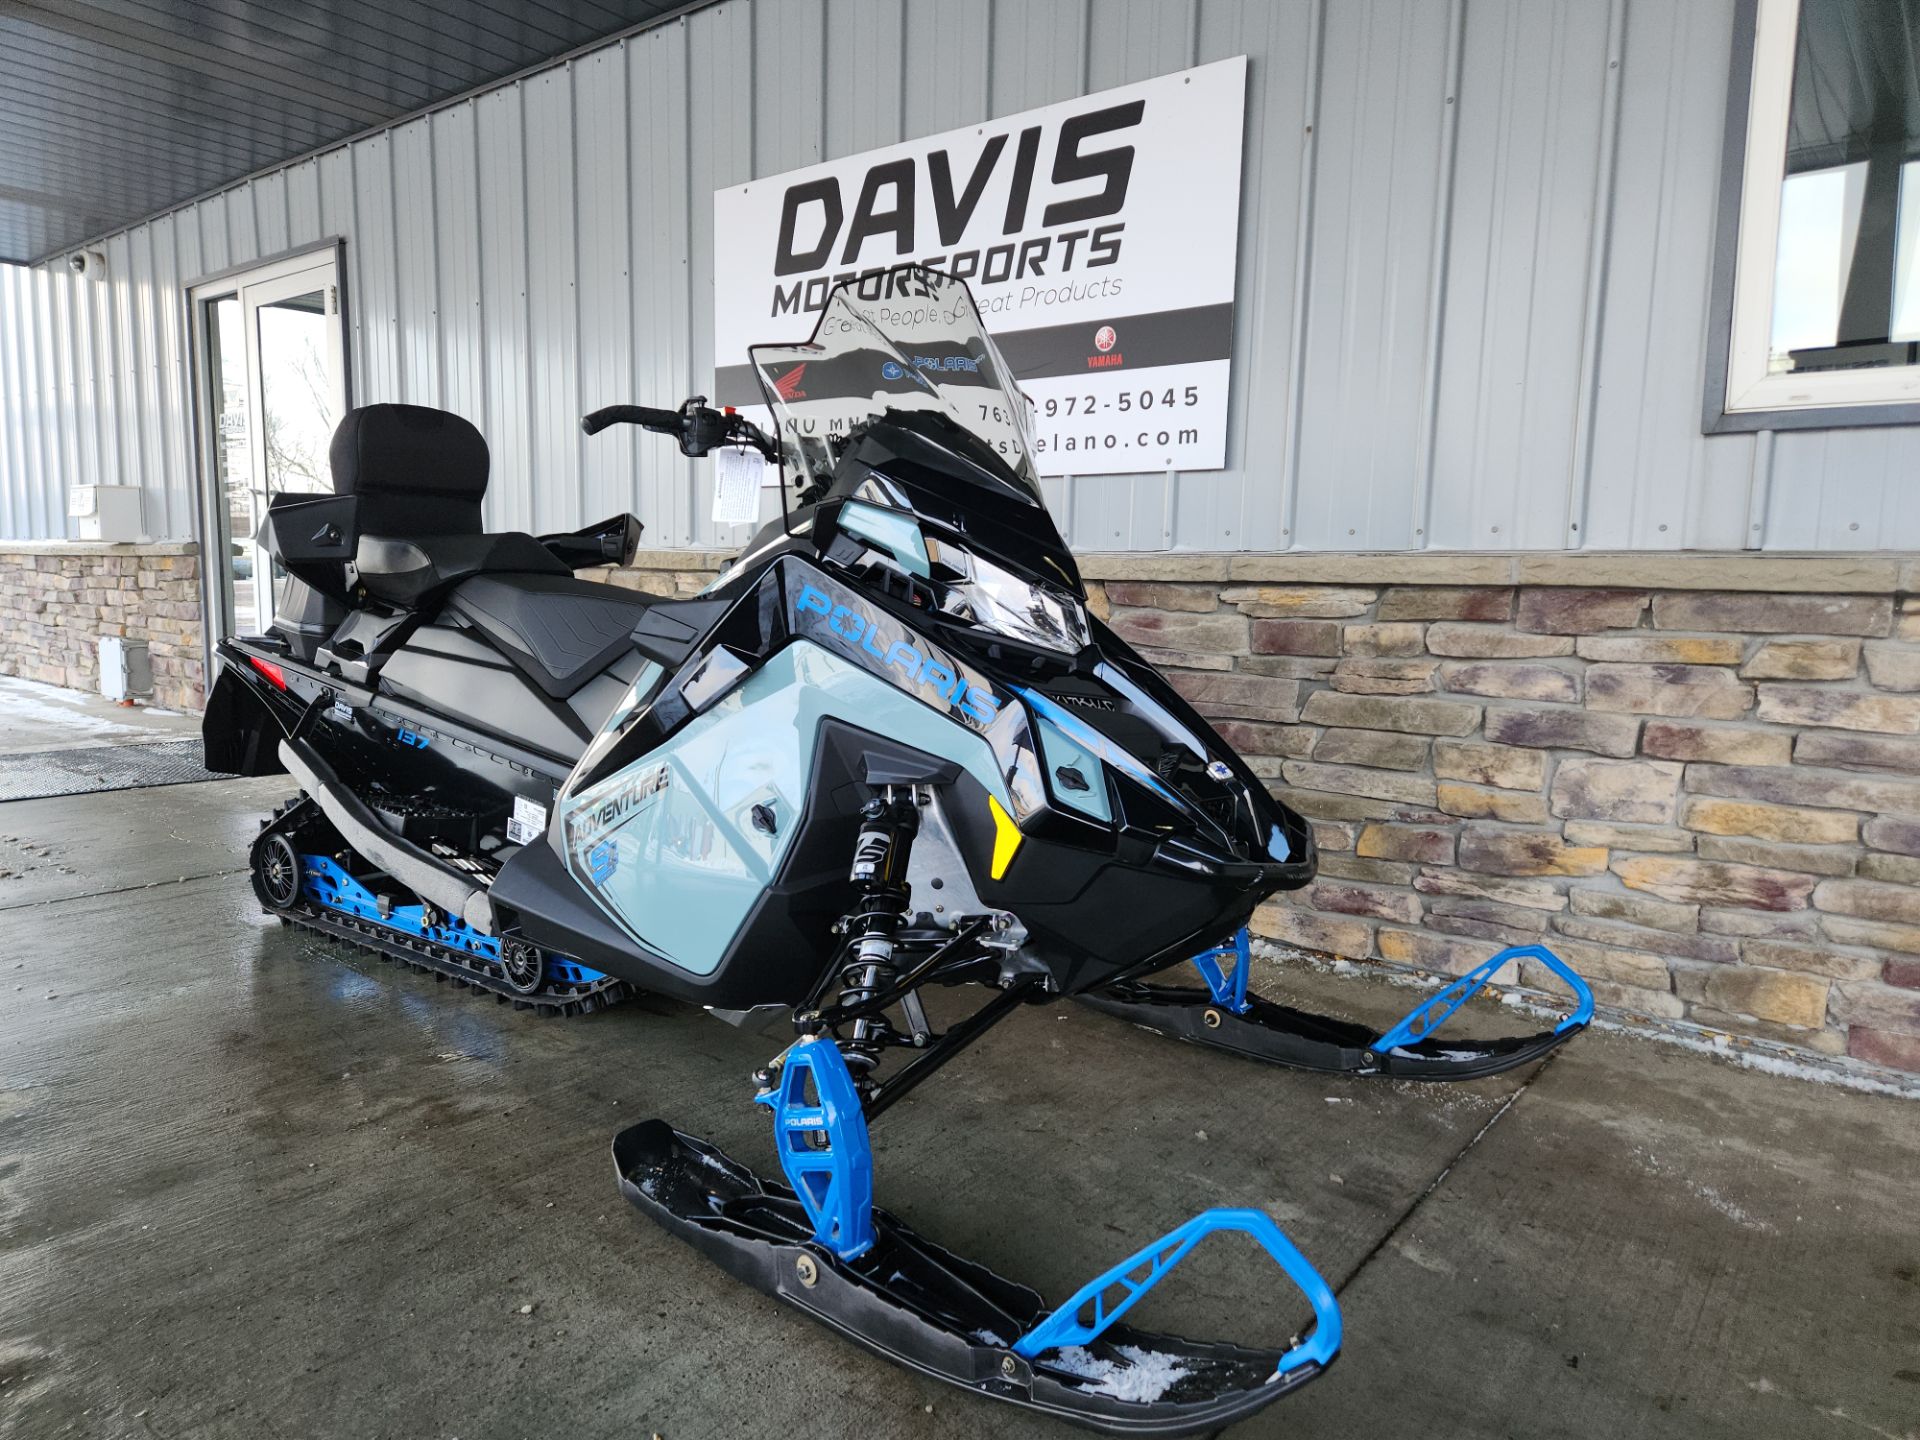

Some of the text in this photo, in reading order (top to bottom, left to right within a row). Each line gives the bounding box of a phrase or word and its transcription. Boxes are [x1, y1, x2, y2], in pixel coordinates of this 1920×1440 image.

[774, 99, 1145, 277] DAVIS
[771, 222, 1125, 317] MOTORSPORTS
[1020, 276, 1123, 309] Products
[1087, 353, 1123, 368] YAMAHA
[796, 583, 1001, 725] POLARIS
[397, 726, 430, 750] 137
[573, 760, 670, 849] ADVENTURE
[784, 1116, 824, 1127] POLARIS
